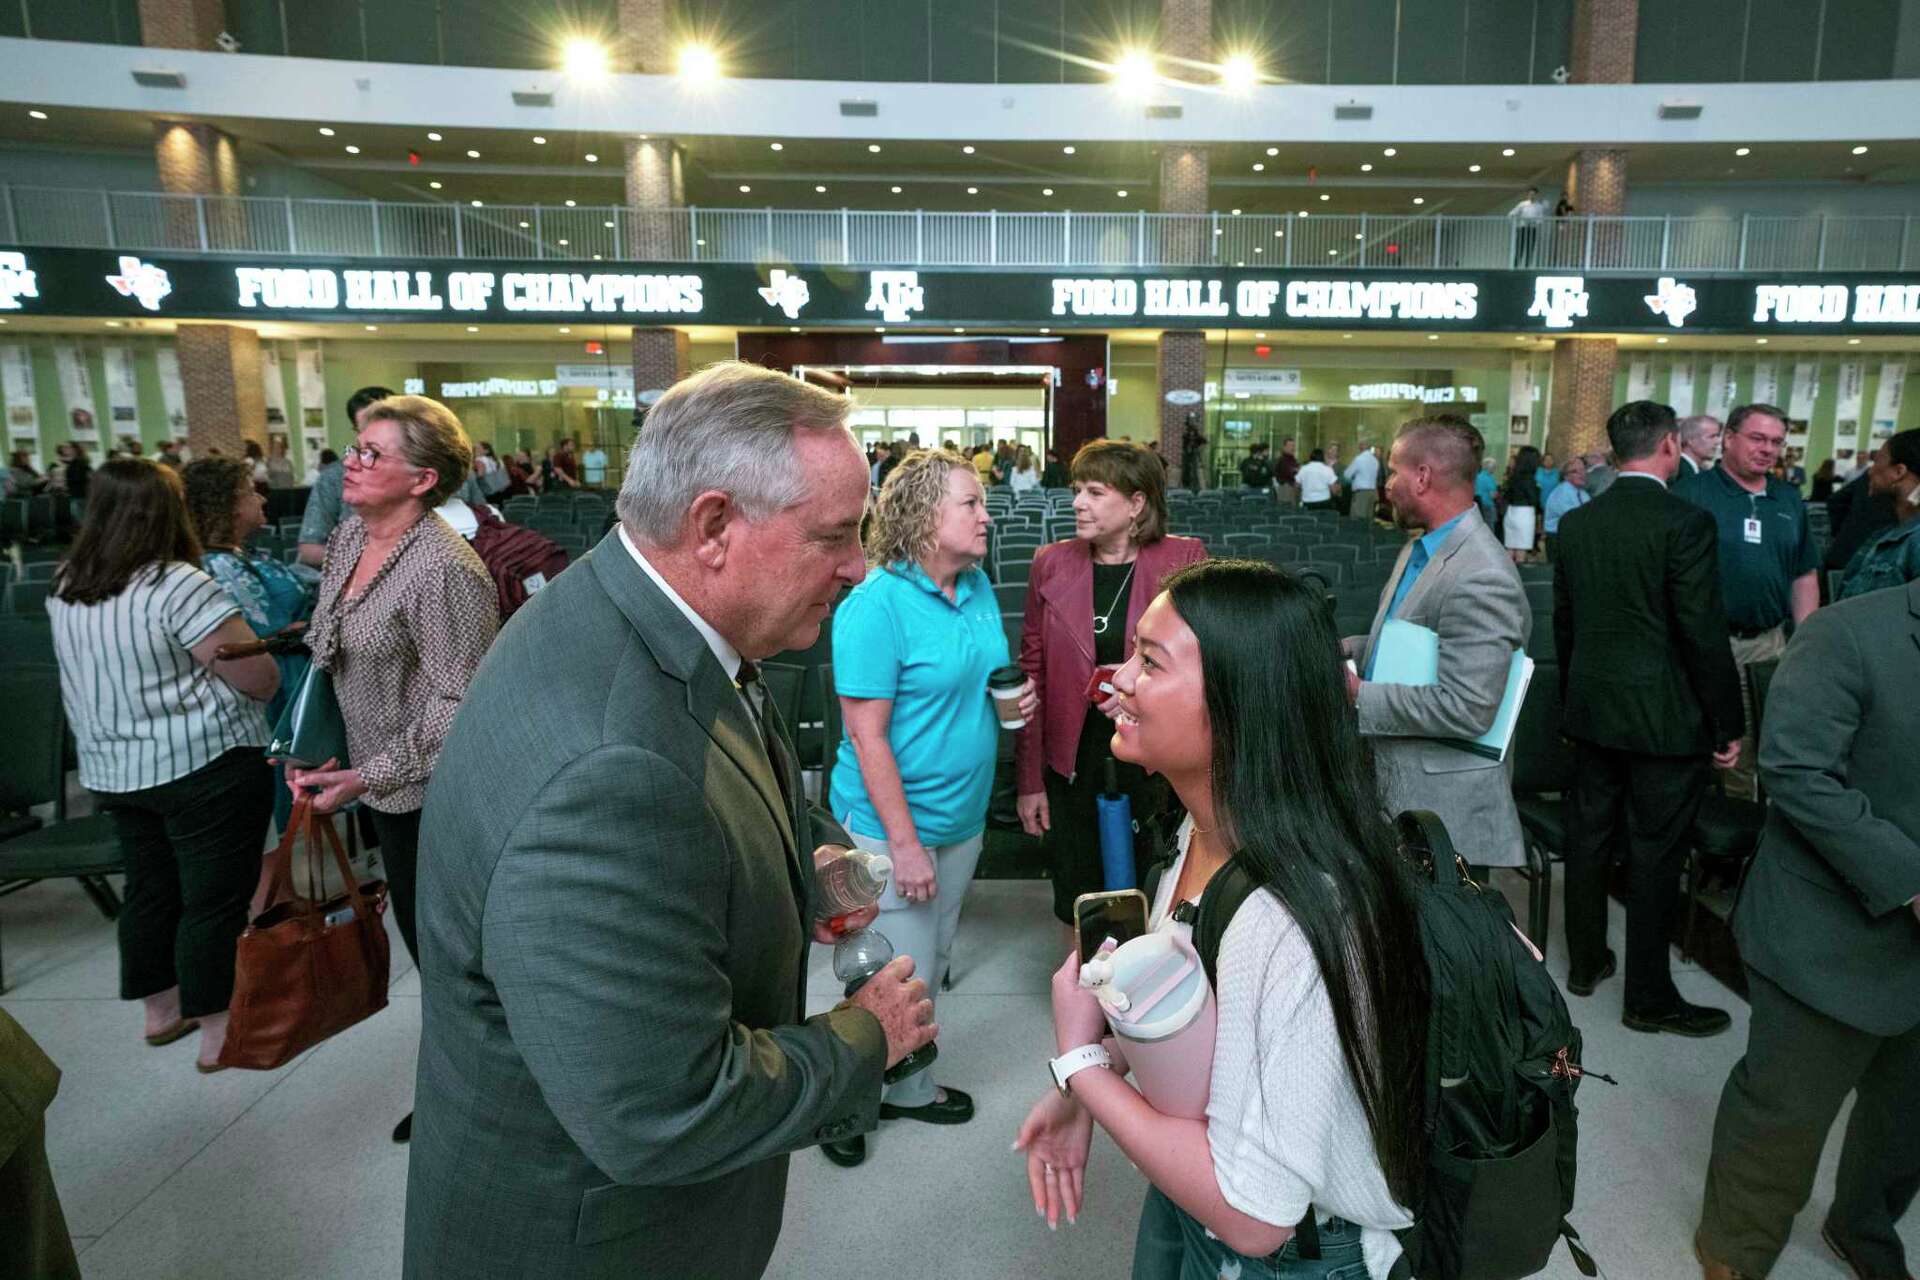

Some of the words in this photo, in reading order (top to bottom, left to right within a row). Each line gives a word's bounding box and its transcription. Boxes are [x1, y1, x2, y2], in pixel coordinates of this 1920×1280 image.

[235, 267, 339, 309] FORD
[342, 269, 444, 311] HALL
[447, 271, 495, 311] OF
[501, 272, 704, 313] CHAMPIONS
[1051, 278, 1138, 316] FORD
[1143, 279, 1230, 317] HALL
[1236, 280, 1280, 317] OF
[1285, 280, 1479, 320] CHAMPIONS
[1753, 284, 1849, 323] FORD
